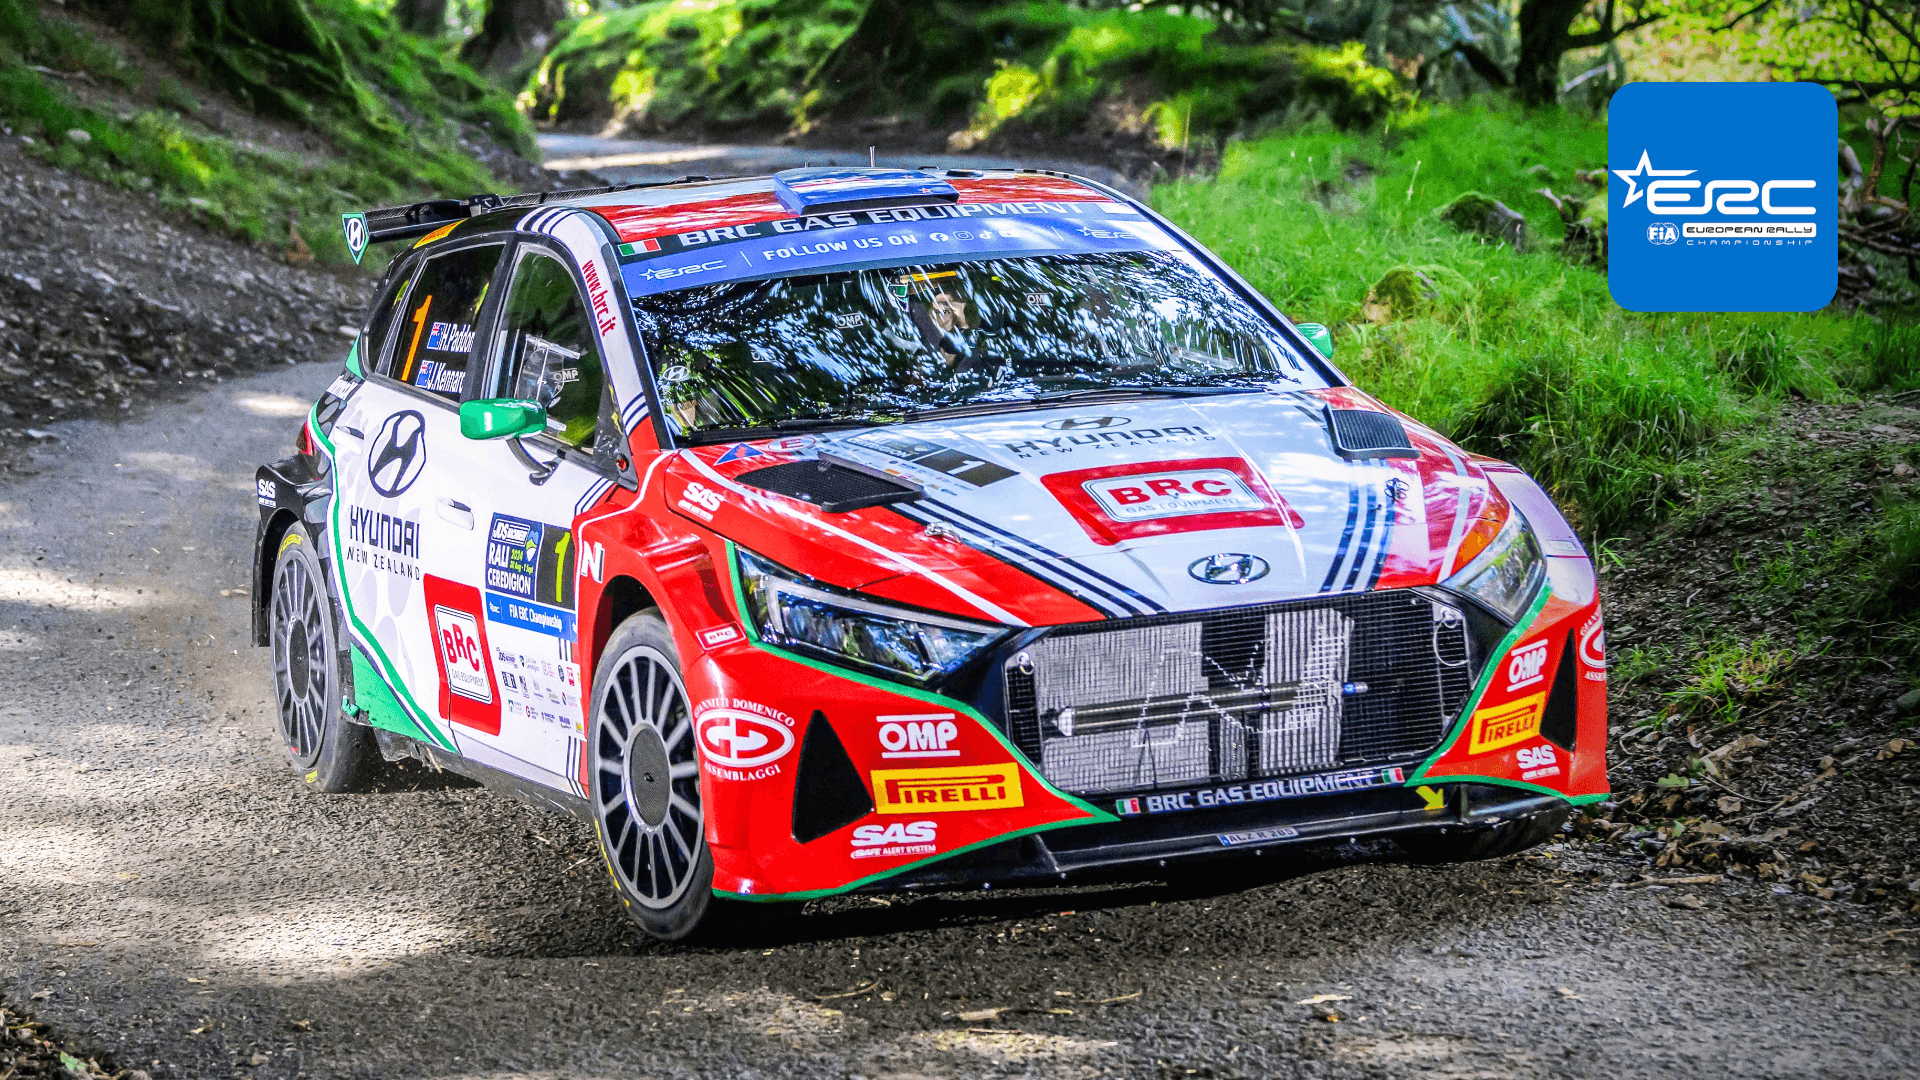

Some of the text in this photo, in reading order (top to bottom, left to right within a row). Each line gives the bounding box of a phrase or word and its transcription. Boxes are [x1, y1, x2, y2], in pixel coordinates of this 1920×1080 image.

[678, 202, 1083, 247] BRC GAS EQUIPMENT
[762, 241, 847, 261] FOLLOW
[853, 237, 883, 249] US
[889, 234, 918, 246] ON
[582, 259, 616, 337] www.brc.it
[401, 295, 433, 382] 1
[1005, 425, 1209, 453] HYUNDAI
[1019, 435, 1215, 459] NEW ZEALAND
[947, 460, 986, 475] 1
[258, 479, 276, 499] SAS
[683, 482, 725, 511] SAS
[1107, 478, 1232, 505] BRC
[1126, 497, 1241, 513] GAS EQUIPMENT
[350, 504, 420, 560] HYUNDAI
[346, 546, 420, 581] NEW ZEALAND
[488, 542, 511, 568] RALI
[554, 531, 571, 603] 1
[580, 540, 605, 584] N
[487, 567, 531, 595] CEREDIGION
[509, 603, 518, 619] FIA
[518, 605, 529, 622] ERC
[529, 608, 563, 633] Championship
[442, 623, 480, 672] BRC
[709, 630, 731, 640] BRC
[1508, 646, 1548, 684] OMP
[733, 697, 795, 727] DOMENICO
[1477, 703, 1538, 745] PIRELLI
[878, 720, 957, 751] OMP
[704, 760, 781, 781] ASSEMBLAGGI
[1516, 744, 1557, 769] SAS
[885, 773, 1005, 804] PIRELLI
[1145, 770, 1375, 813] BRC GAS EQUIPMENT
[850, 820, 938, 847] SAS
[882, 846, 906, 855] ALERT
[906, 844, 937, 854] SYSTEM
